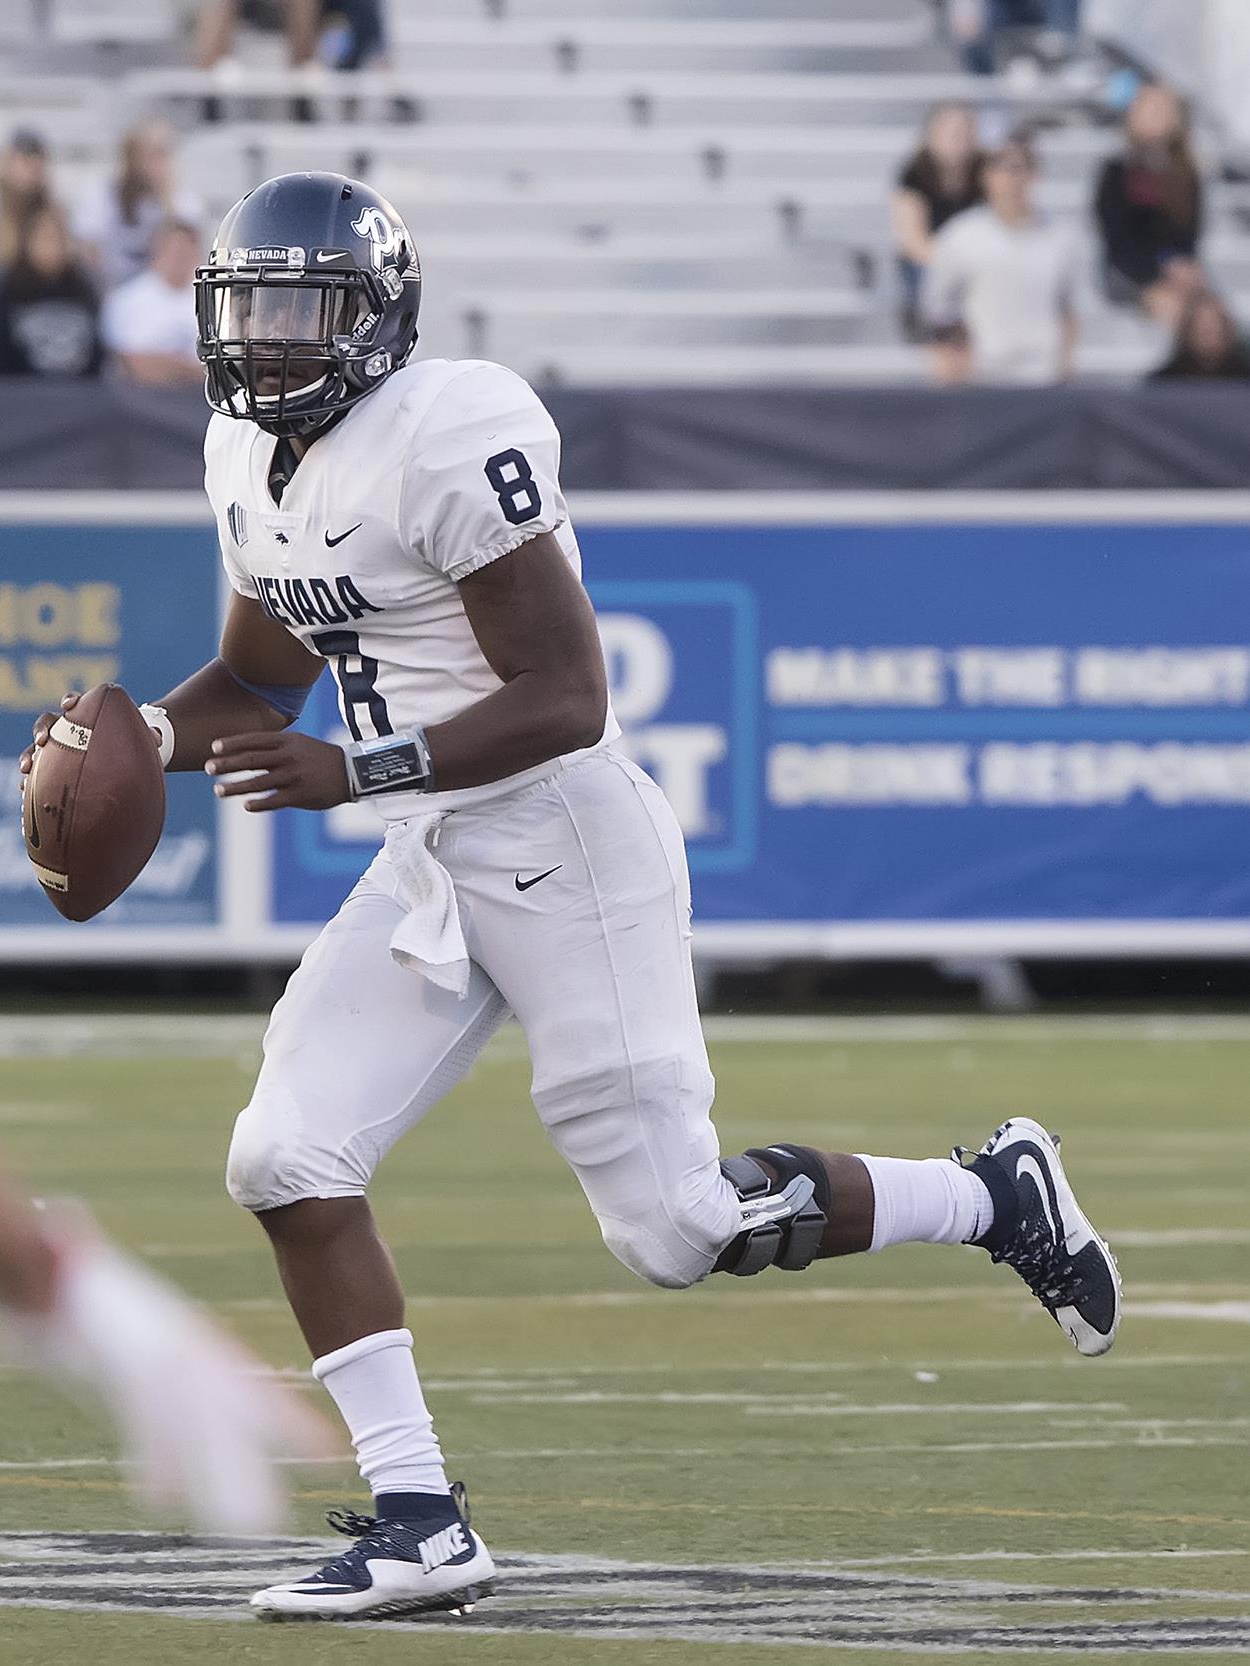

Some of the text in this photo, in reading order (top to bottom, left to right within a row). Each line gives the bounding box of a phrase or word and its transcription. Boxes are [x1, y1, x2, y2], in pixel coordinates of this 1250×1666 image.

[248, 249, 288, 261] NEVADA
[483, 447, 542, 526] 8
[250, 574, 385, 627] NEVADA
[311, 630, 395, 741] 8
[767, 646, 1249, 706] MAKE THE RIGHT
[767, 742, 969, 807] DRINK
[980, 742, 1250, 807] RESPON
[417, 1522, 470, 1575] NIKE
